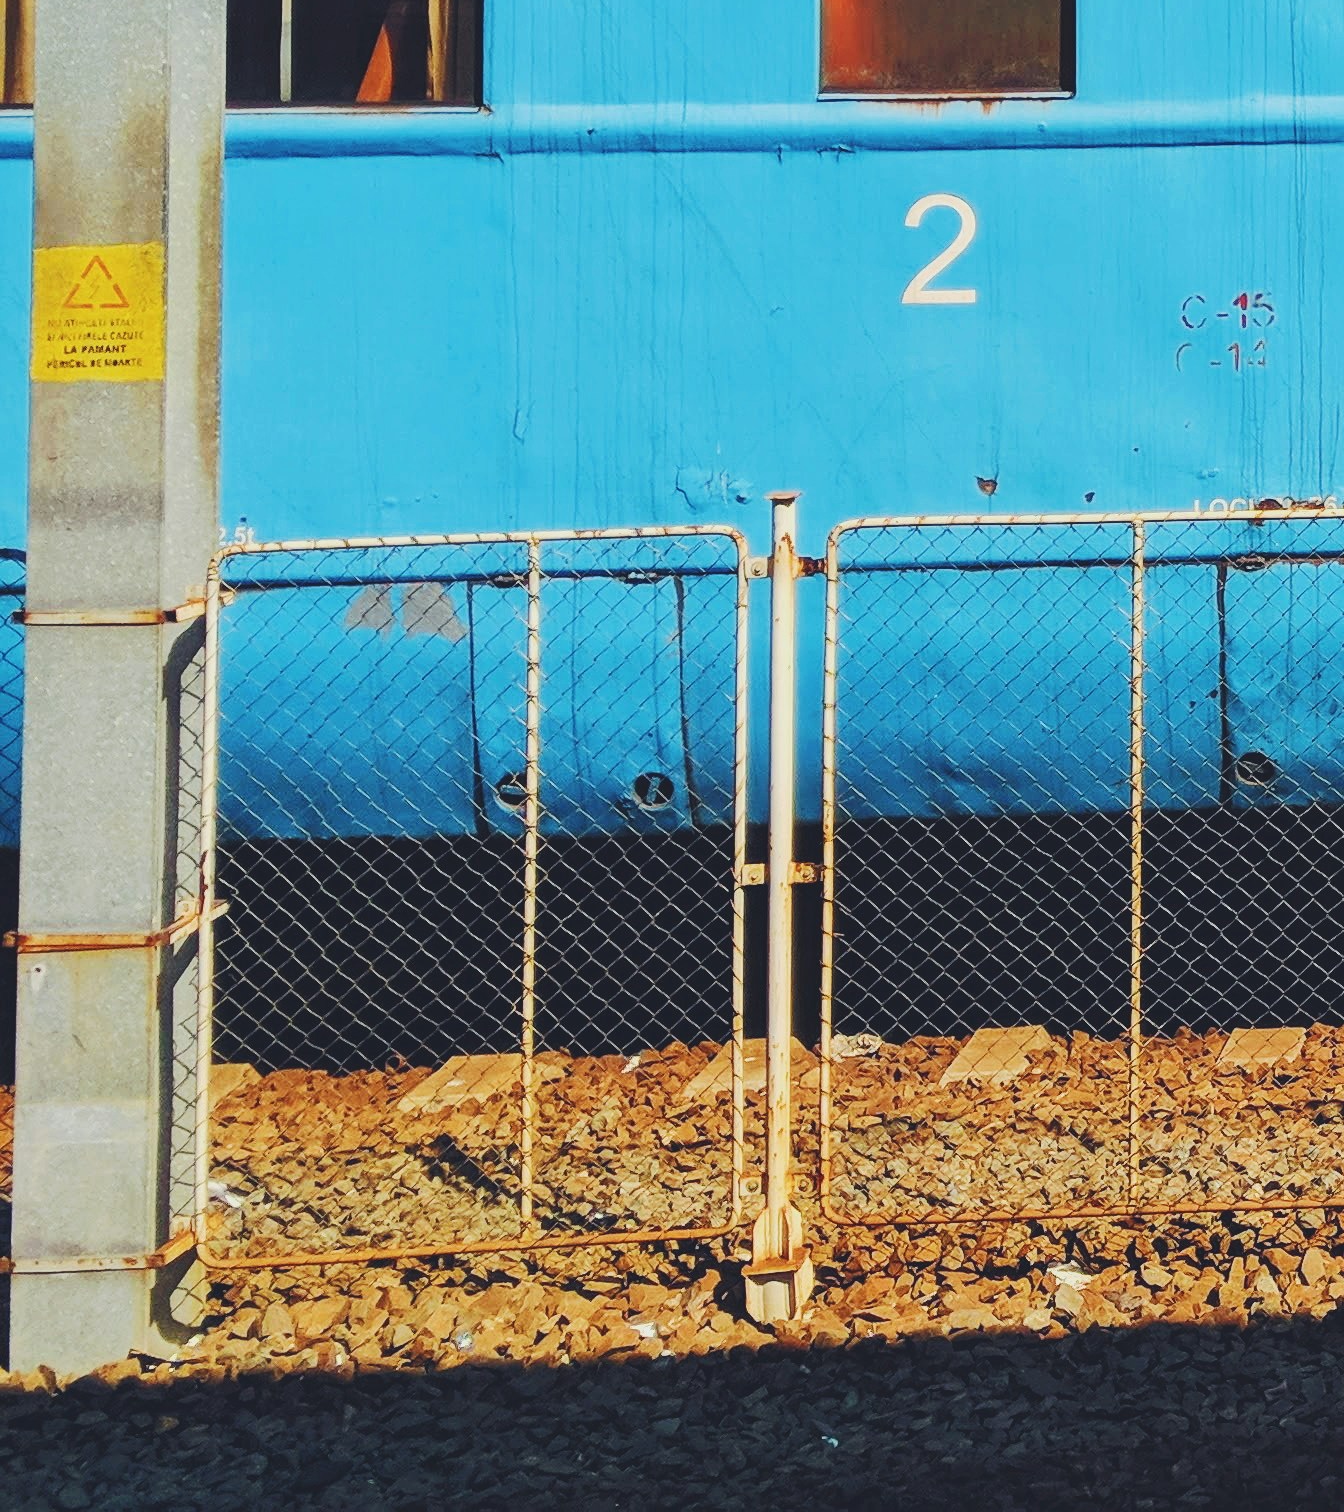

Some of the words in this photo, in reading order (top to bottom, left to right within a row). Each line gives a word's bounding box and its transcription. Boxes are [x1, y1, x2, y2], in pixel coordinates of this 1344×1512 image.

[901, 193, 976, 304] 2
[1182, 292, 1275, 329] C-15
[63, 344, 77, 355] LA
